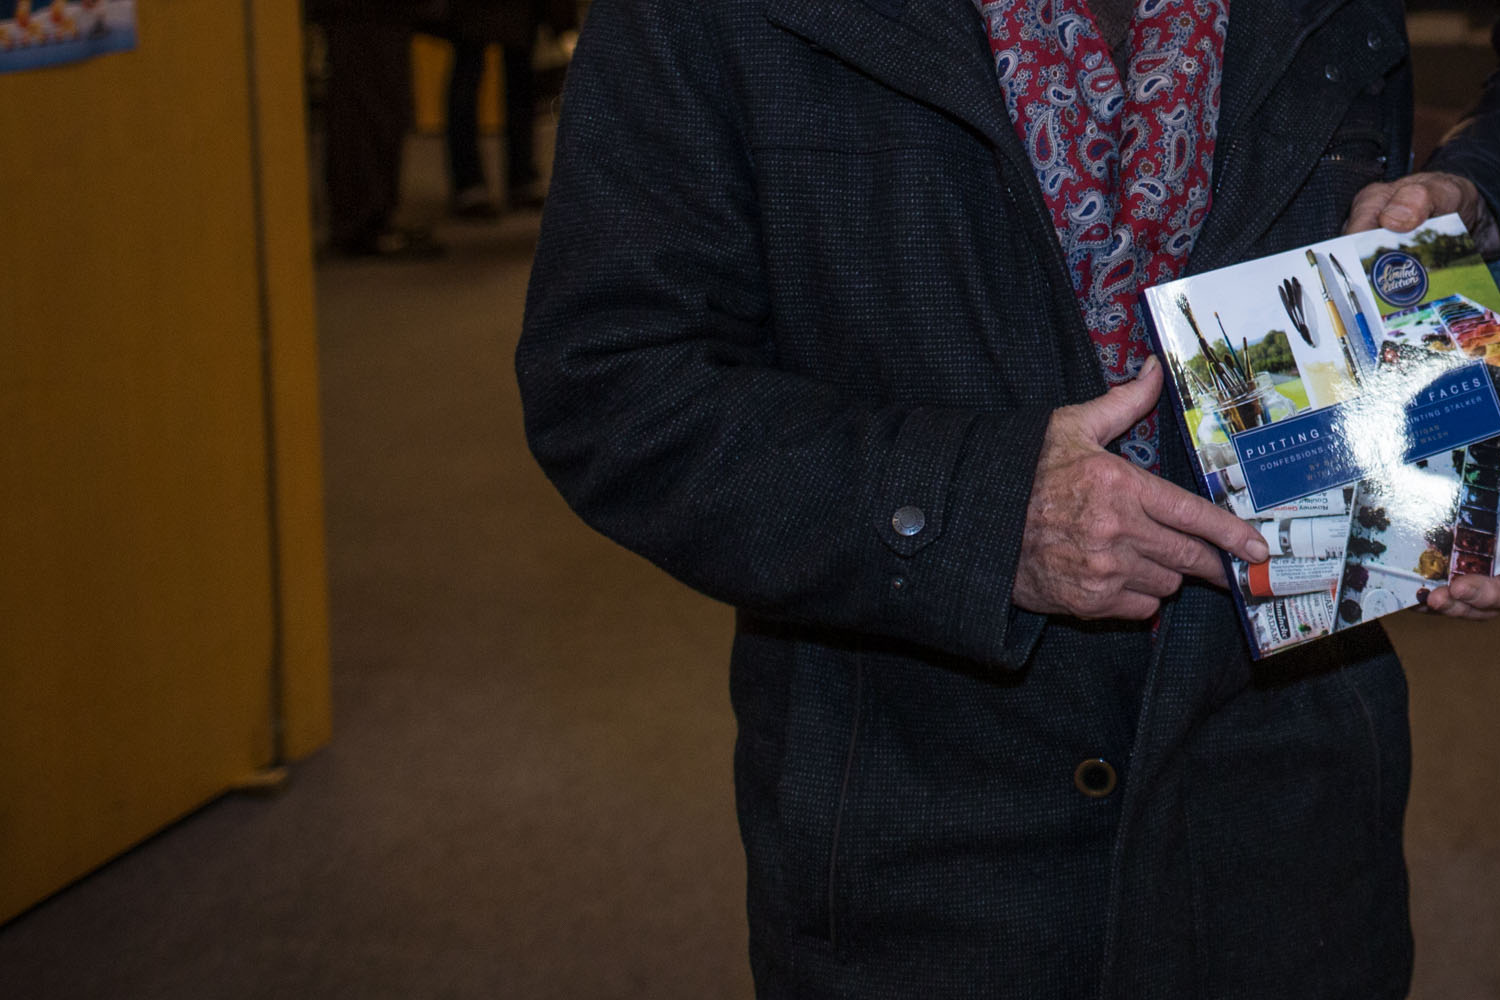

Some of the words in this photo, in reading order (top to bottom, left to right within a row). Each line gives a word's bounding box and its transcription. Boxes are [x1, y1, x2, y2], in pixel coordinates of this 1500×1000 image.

[1246, 428, 1320, 459] PUTTING
[1428, 378, 1481, 402] FACES
[1260, 446, 1324, 472] CONFESSIONS
[1444, 396, 1482, 414] STALKER
